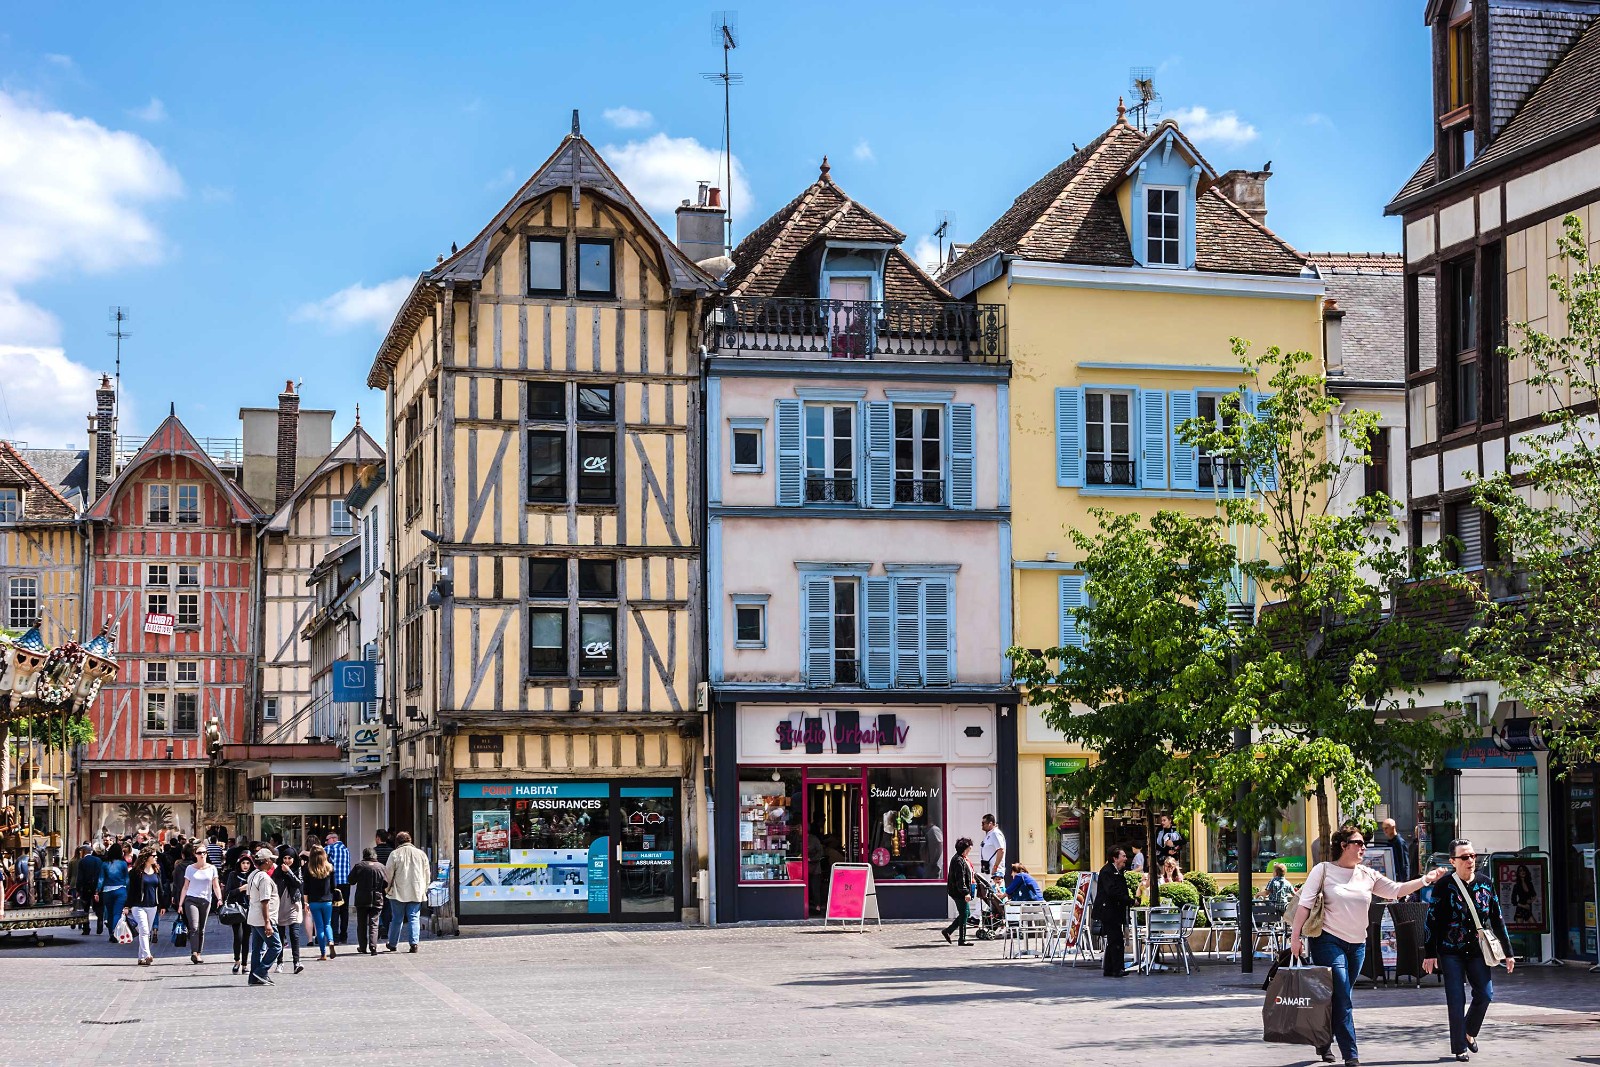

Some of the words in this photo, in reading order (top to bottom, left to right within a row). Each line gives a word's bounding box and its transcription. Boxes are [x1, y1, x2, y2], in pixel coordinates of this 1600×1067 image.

[354, 728, 380, 743] CA
[775, 722, 826, 744] Studio
[834, 721, 886, 744] Urbain
[893, 725, 910, 744] IV
[482, 786, 513, 795] POINT
[515, 786, 558, 795] HABITAT
[870, 787, 897, 798] Studio
[899, 786, 927, 798] Urbain
[930, 788, 940, 798] IV
[516, 801, 528, 809] ET
[531, 800, 601, 809] ASSURANCES
[1275, 996, 1311, 1006] DAMART
